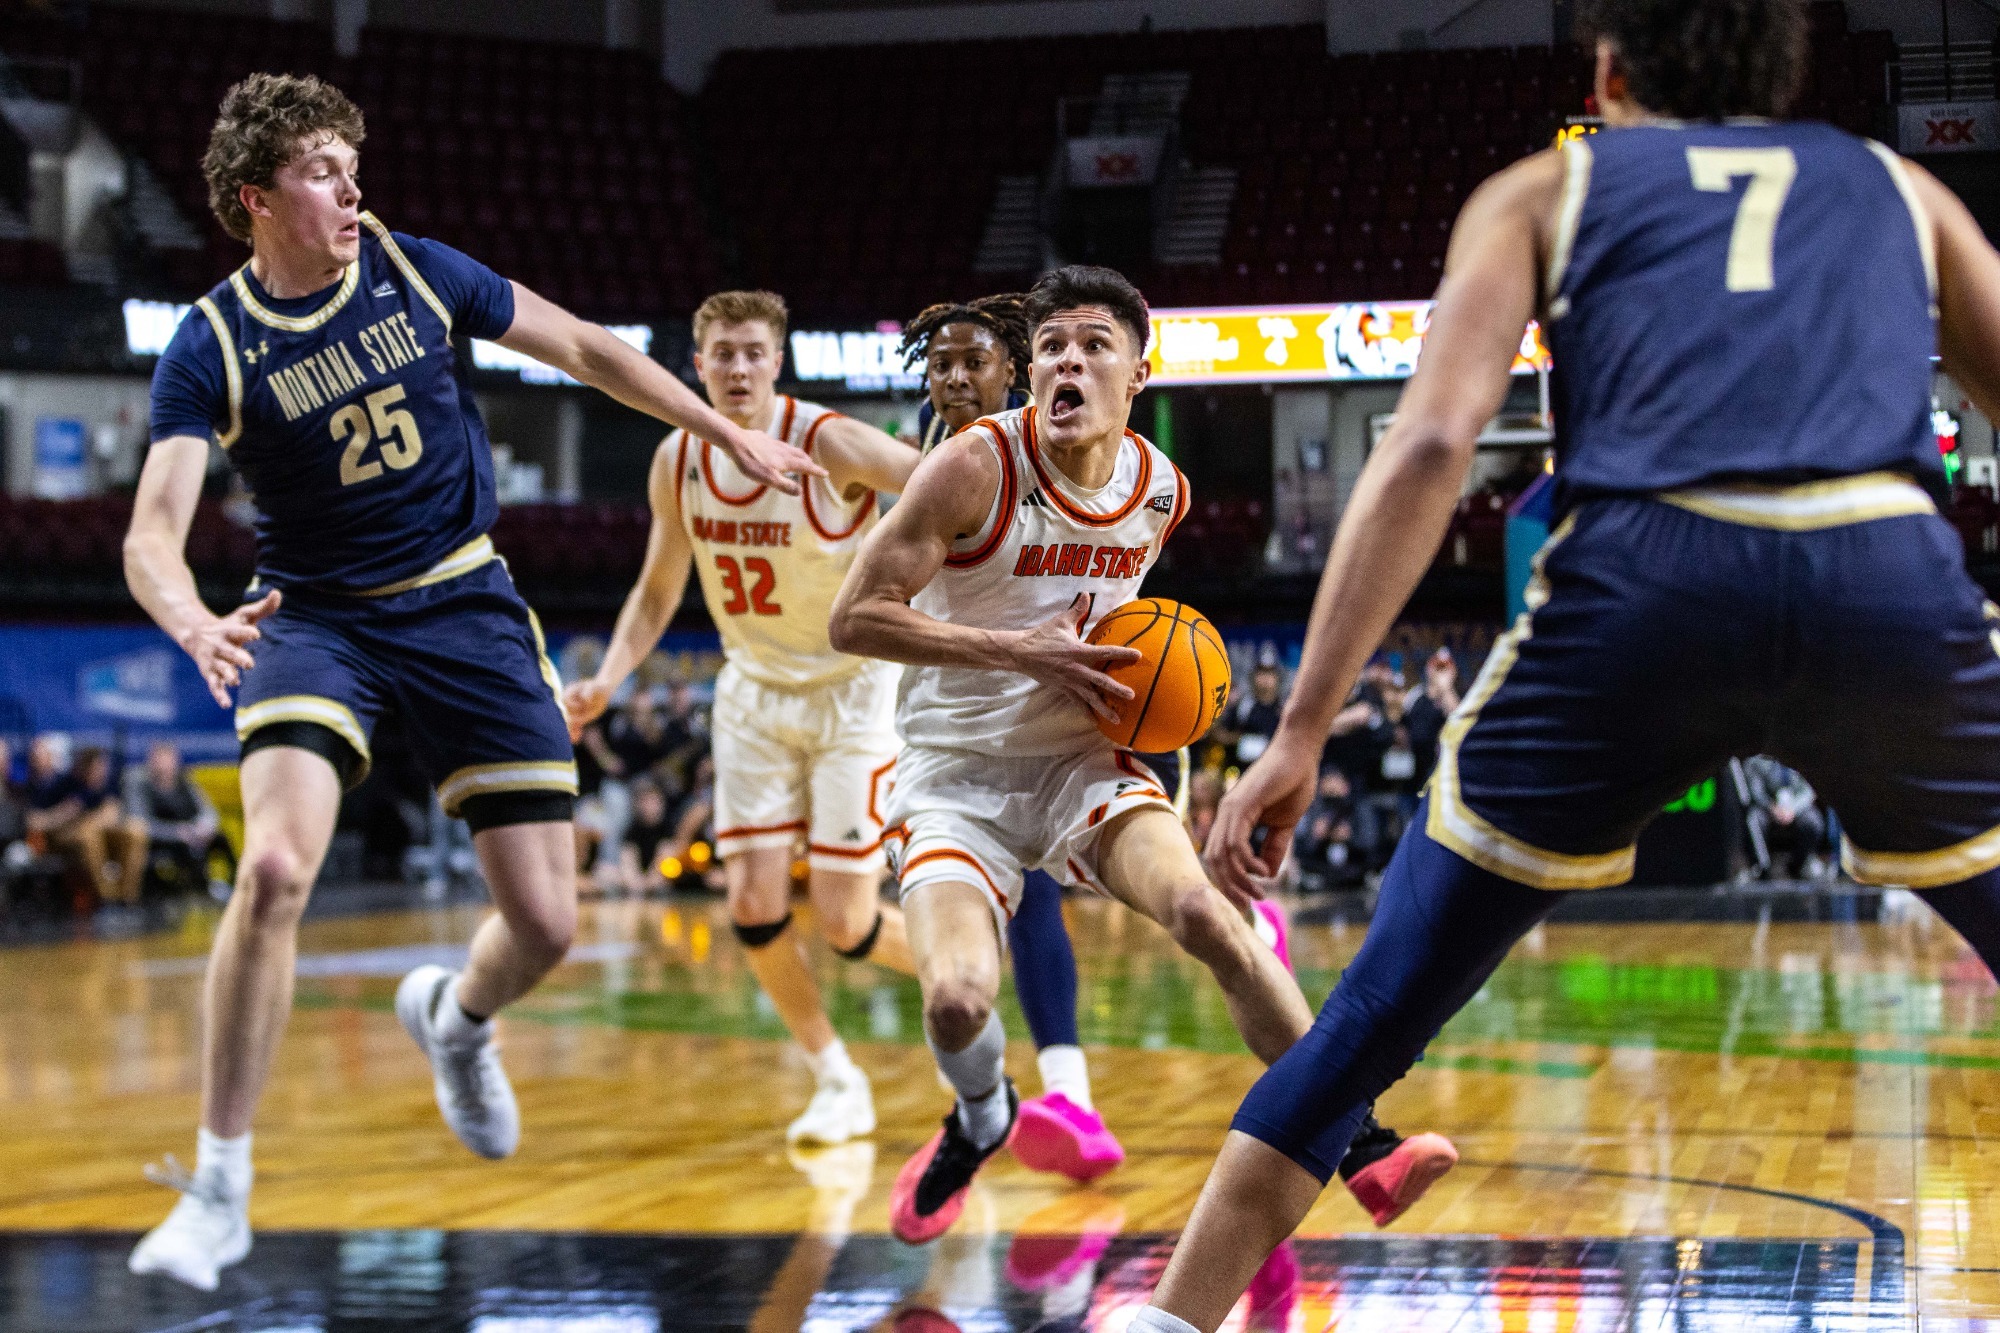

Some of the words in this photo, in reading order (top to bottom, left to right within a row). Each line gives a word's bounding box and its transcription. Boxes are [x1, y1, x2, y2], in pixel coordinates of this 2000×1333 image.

[1685, 146, 1798, 292] 7
[266, 340, 368, 422] MONTANA
[358, 311, 426, 375] STATE
[329, 383, 424, 487] 25
[1153, 496, 1171, 509] SKY
[739, 520, 792, 548] STATE
[1012, 543, 1094, 577] IDAHO
[1088, 545, 1150, 580] STATE
[714, 554, 783, 616] 32
